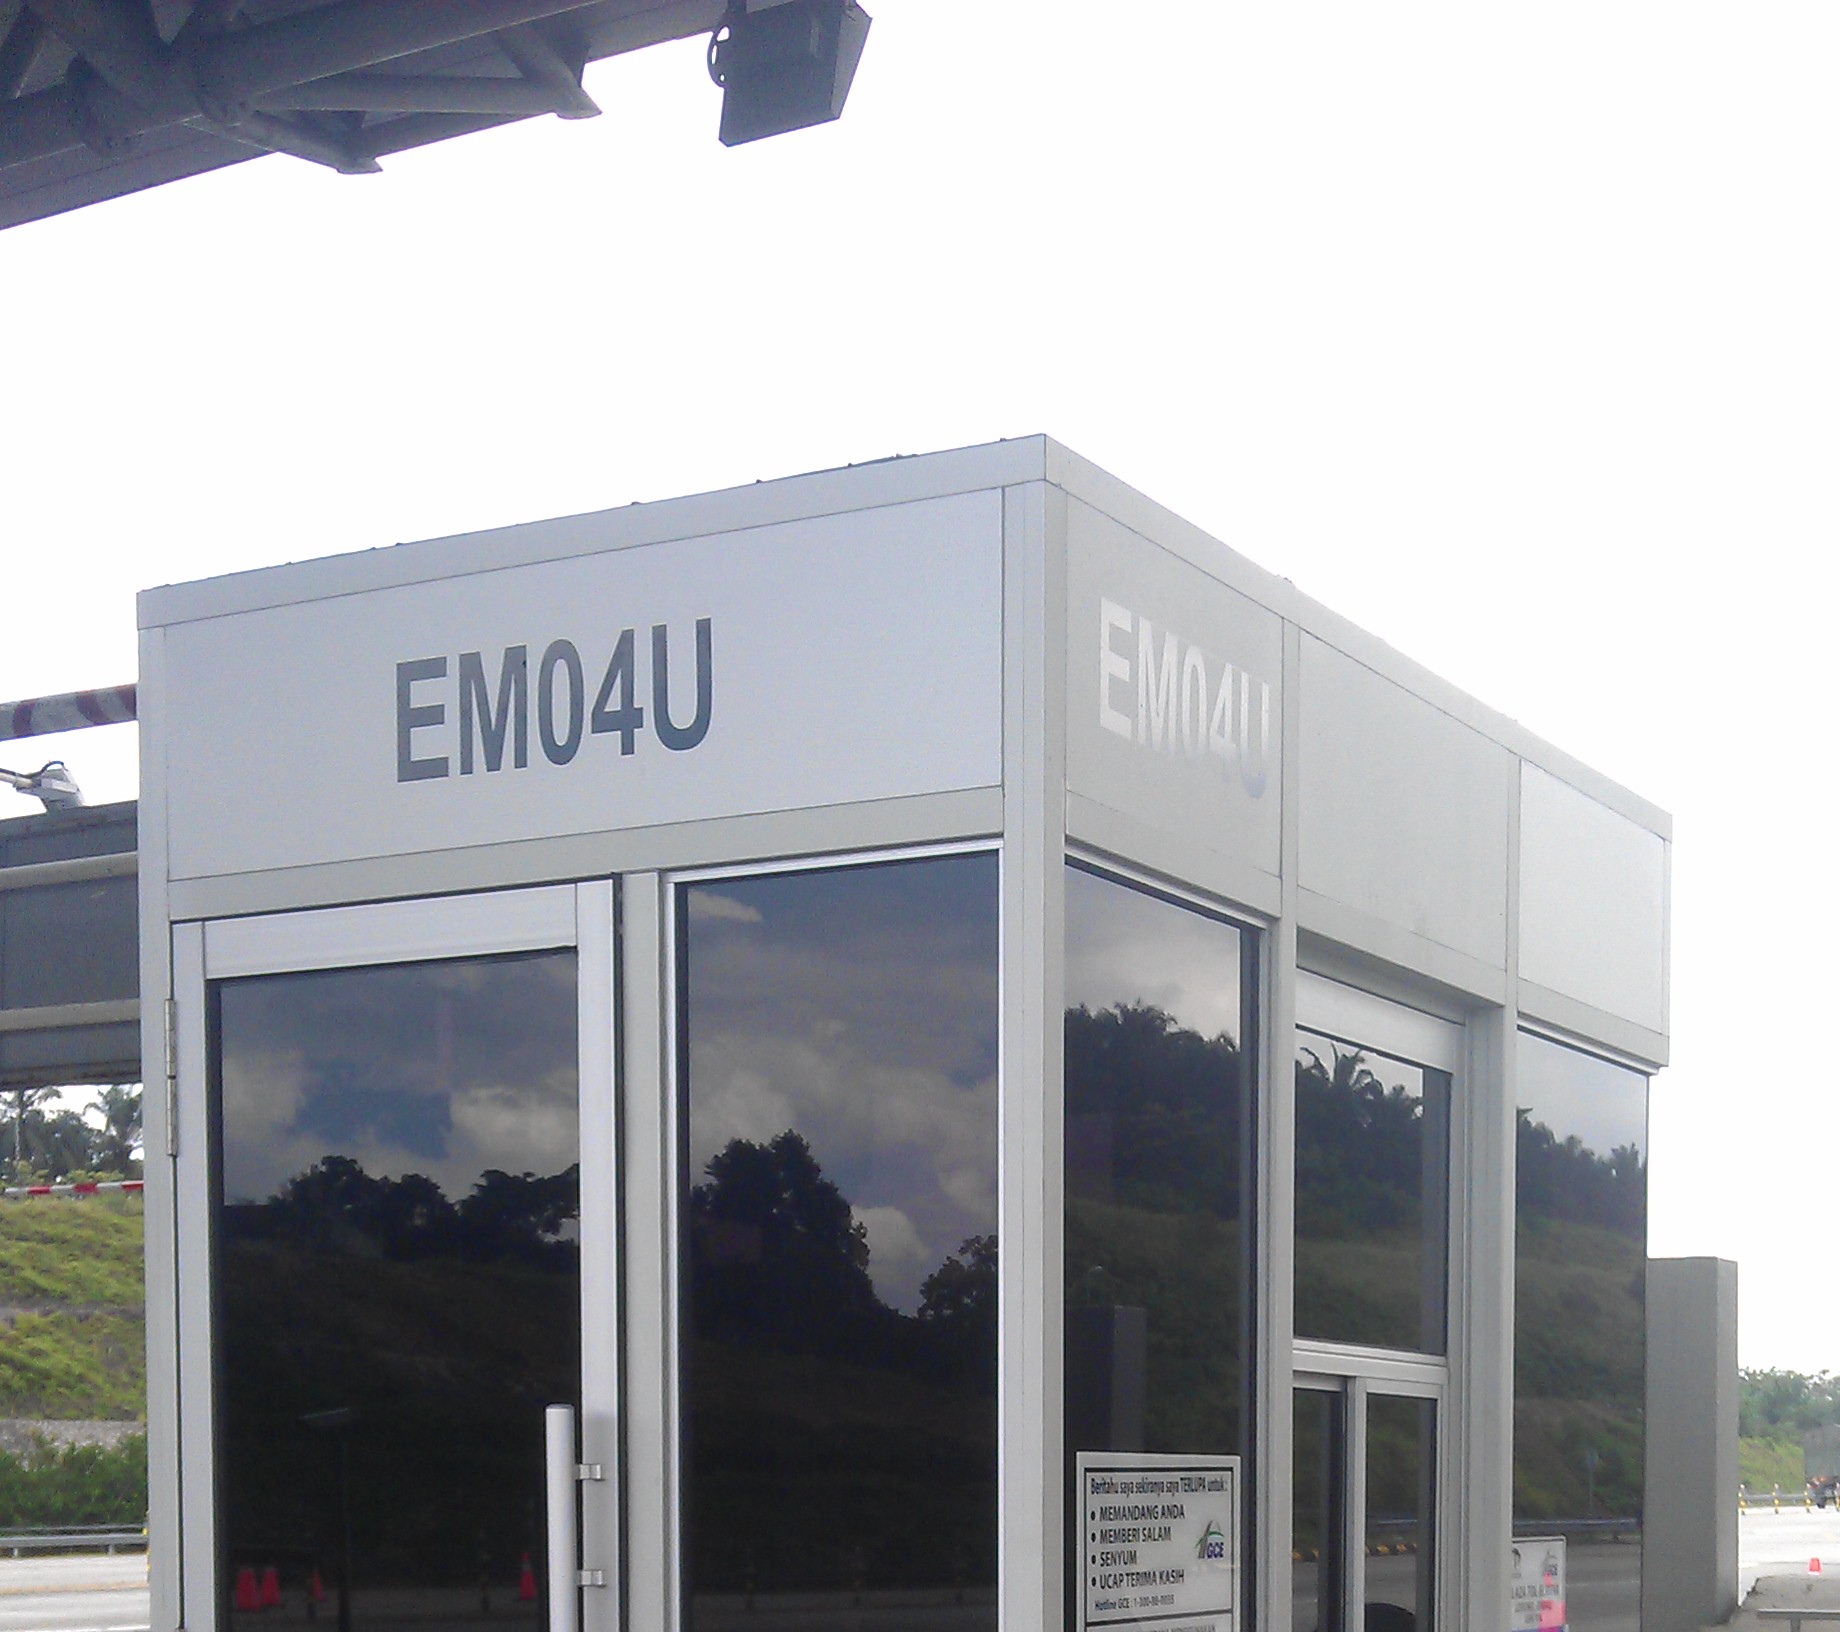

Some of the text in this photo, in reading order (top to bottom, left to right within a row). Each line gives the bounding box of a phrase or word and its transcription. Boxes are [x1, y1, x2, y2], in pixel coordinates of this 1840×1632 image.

[396, 616, 712, 782] EM04U
[1100, 597, 1269, 798] EM04U
[1091, 1476, 1119, 1494] Beritahu
[1120, 1481, 1134, 1498] saya
[1135, 1477, 1164, 1497] sekiranya
[1166, 1480, 1179, 1497] saya
[1180, 1477, 1206, 1493] TERLUPA
[1100, 1504, 1185, 1521] MEMANDANG ANDA
[1100, 1526, 1171, 1544] MEMBERI SALAM
[1100, 1550, 1137, 1567] SENYUM
[1206, 1542, 1225, 1559] GCE
[1100, 1569, 1185, 1590] UCAP TERIMA KASIH
